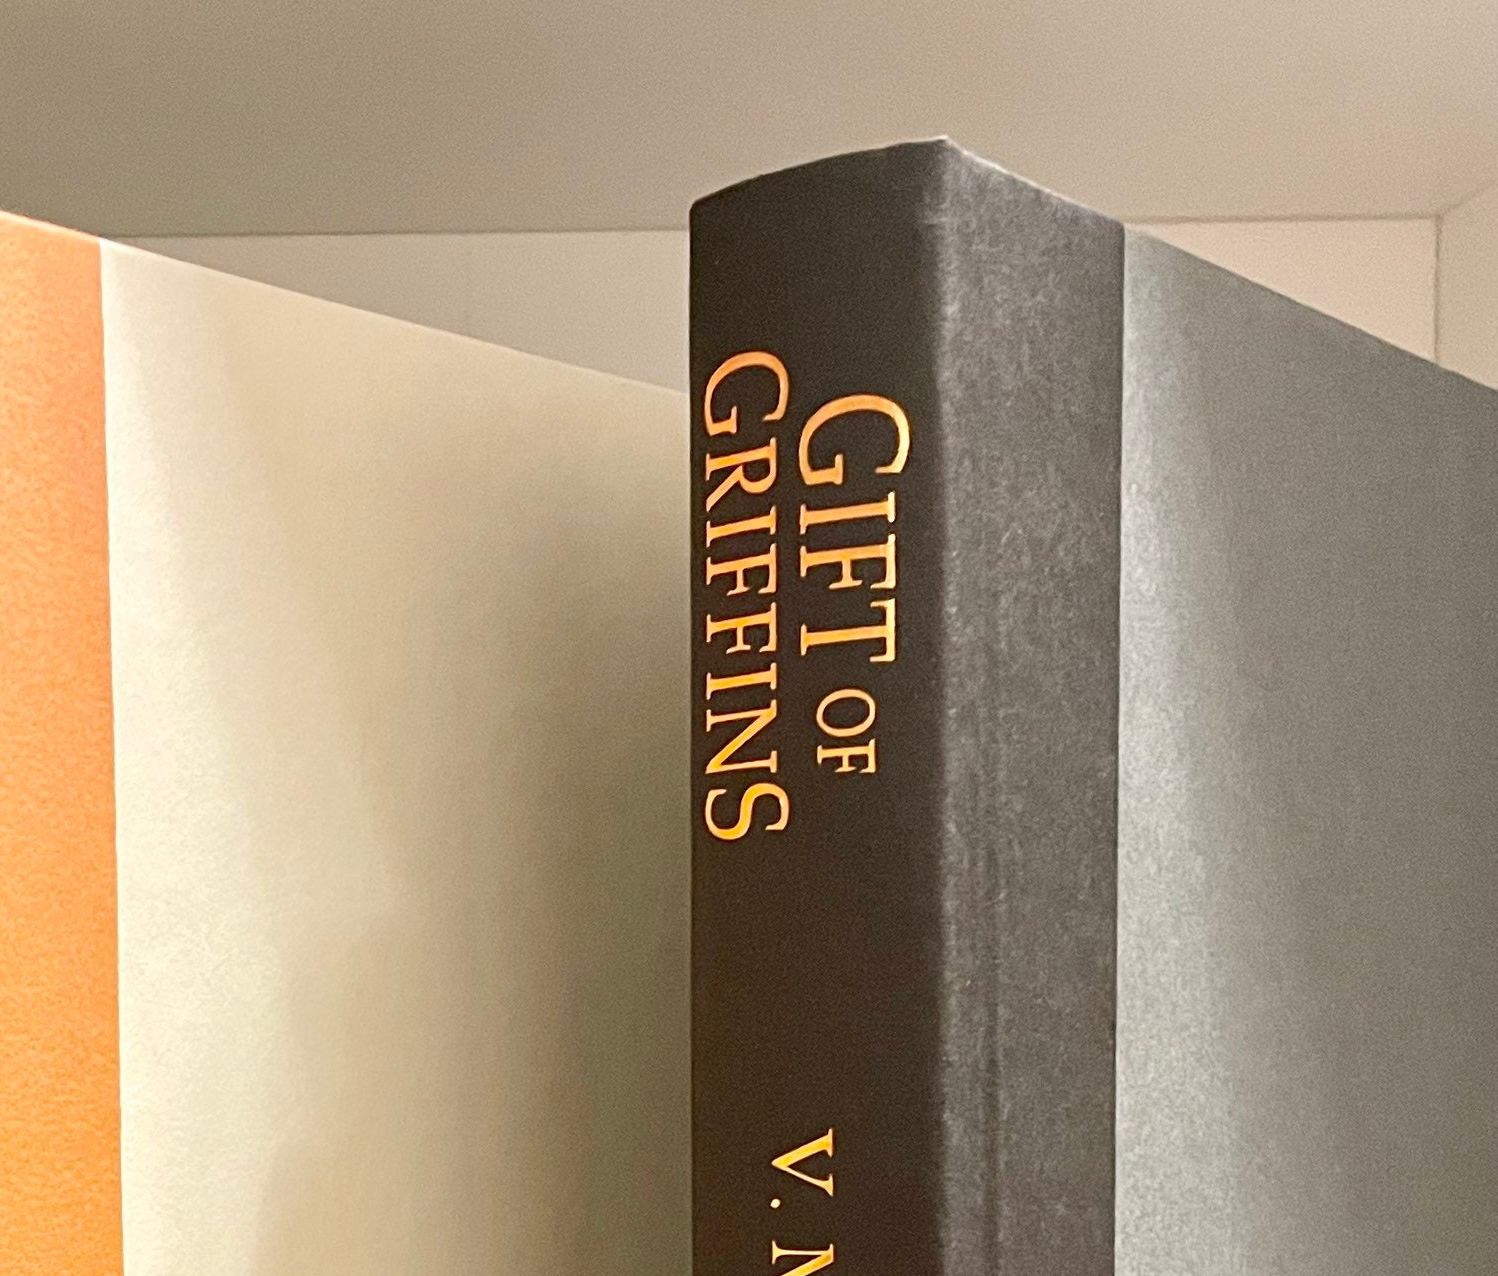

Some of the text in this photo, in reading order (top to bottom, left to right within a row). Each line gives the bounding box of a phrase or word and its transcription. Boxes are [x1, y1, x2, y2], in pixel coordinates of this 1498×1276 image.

[704, 351, 790, 841] GRIFFINS
[798, 393, 911, 774] GIFT OF
[770, 1127, 835, 1209] V.
